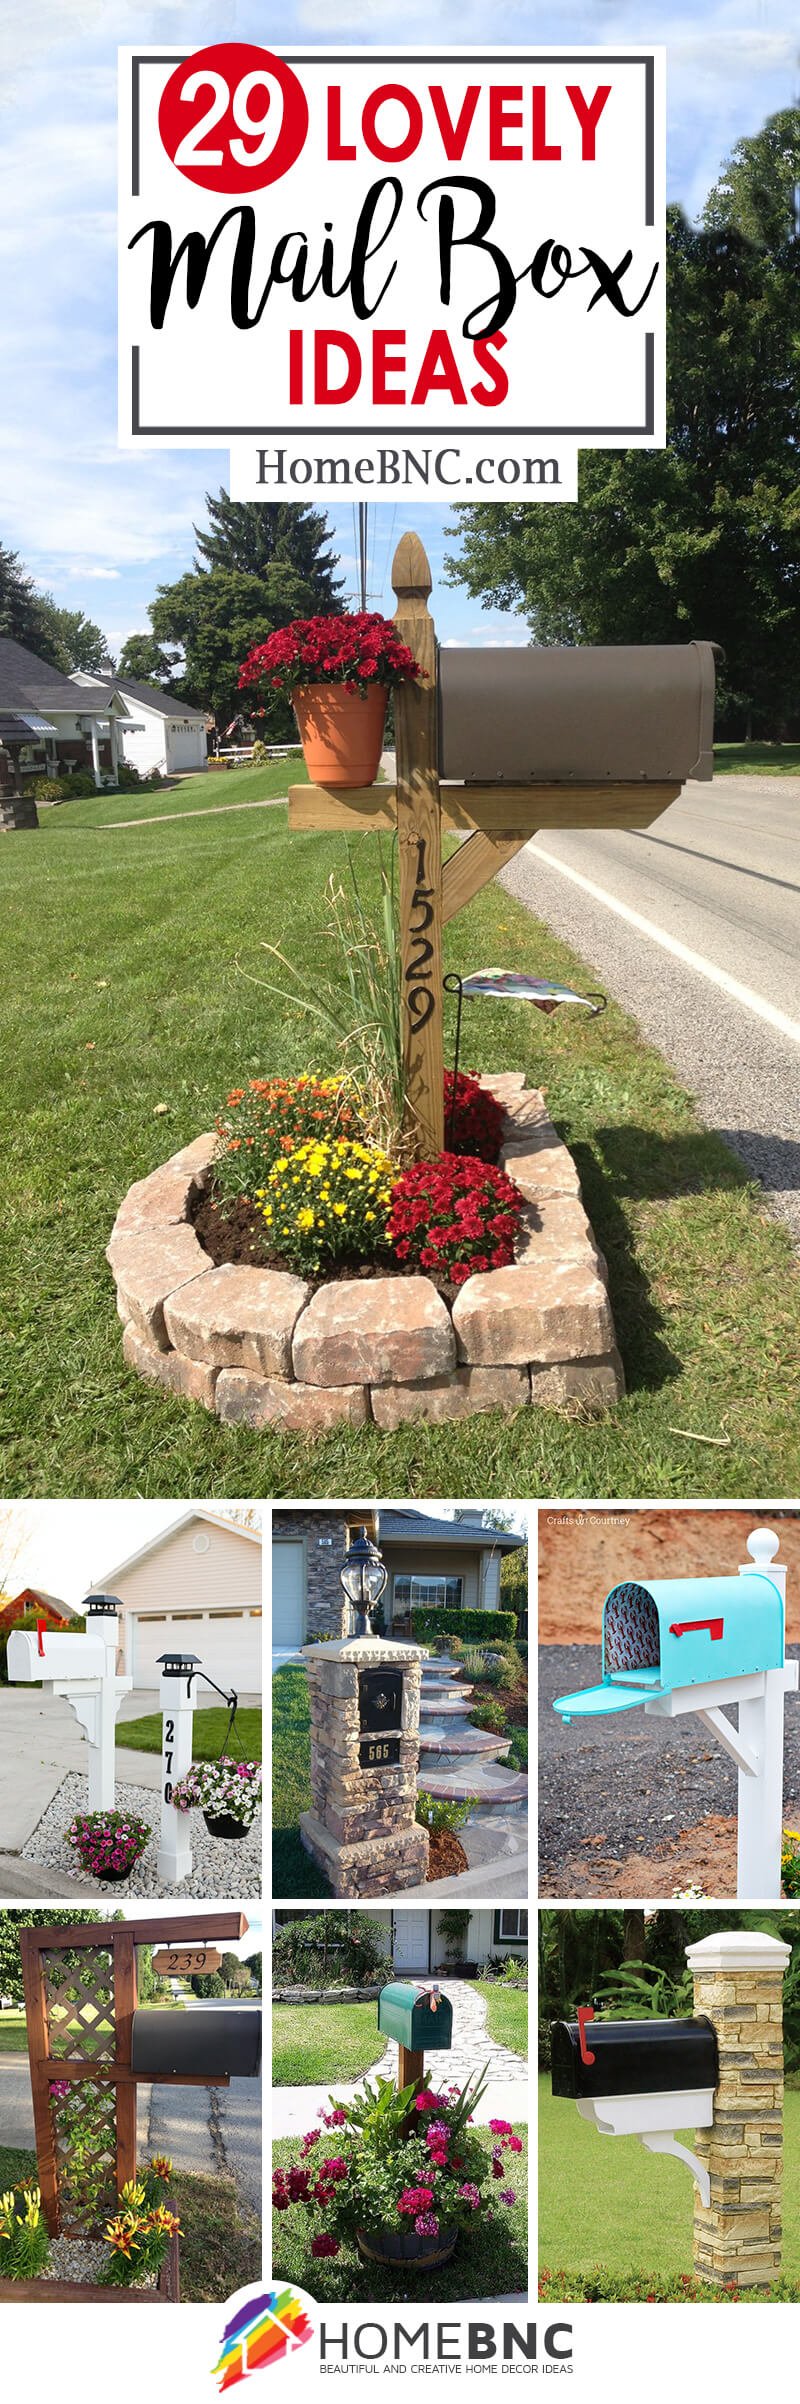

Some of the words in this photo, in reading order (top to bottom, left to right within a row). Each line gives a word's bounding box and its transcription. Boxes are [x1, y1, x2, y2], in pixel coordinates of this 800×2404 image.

[404, 838, 436, 1035] 1529
[368, 1743, 390, 1761] 565
[167, 1952, 207, 1971] 239
